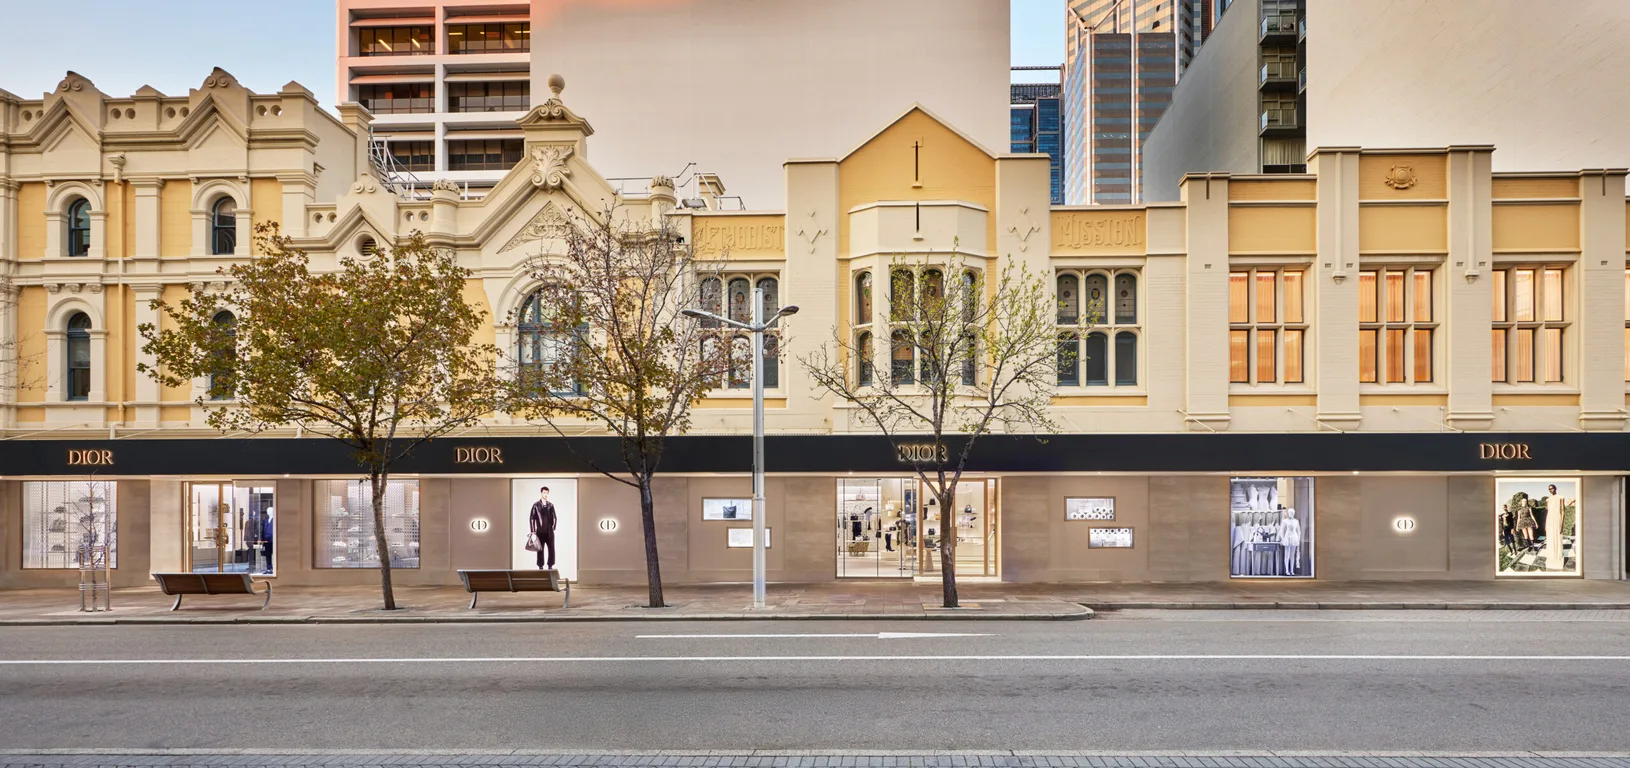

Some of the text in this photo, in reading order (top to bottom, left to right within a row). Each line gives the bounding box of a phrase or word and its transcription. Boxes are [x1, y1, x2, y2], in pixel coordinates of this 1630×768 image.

[67, 449, 114, 466] DIOR
[455, 447, 504, 464] DIOR
[897, 444, 949, 462] DIOR
[1479, 443, 1533, 460] DIOR
